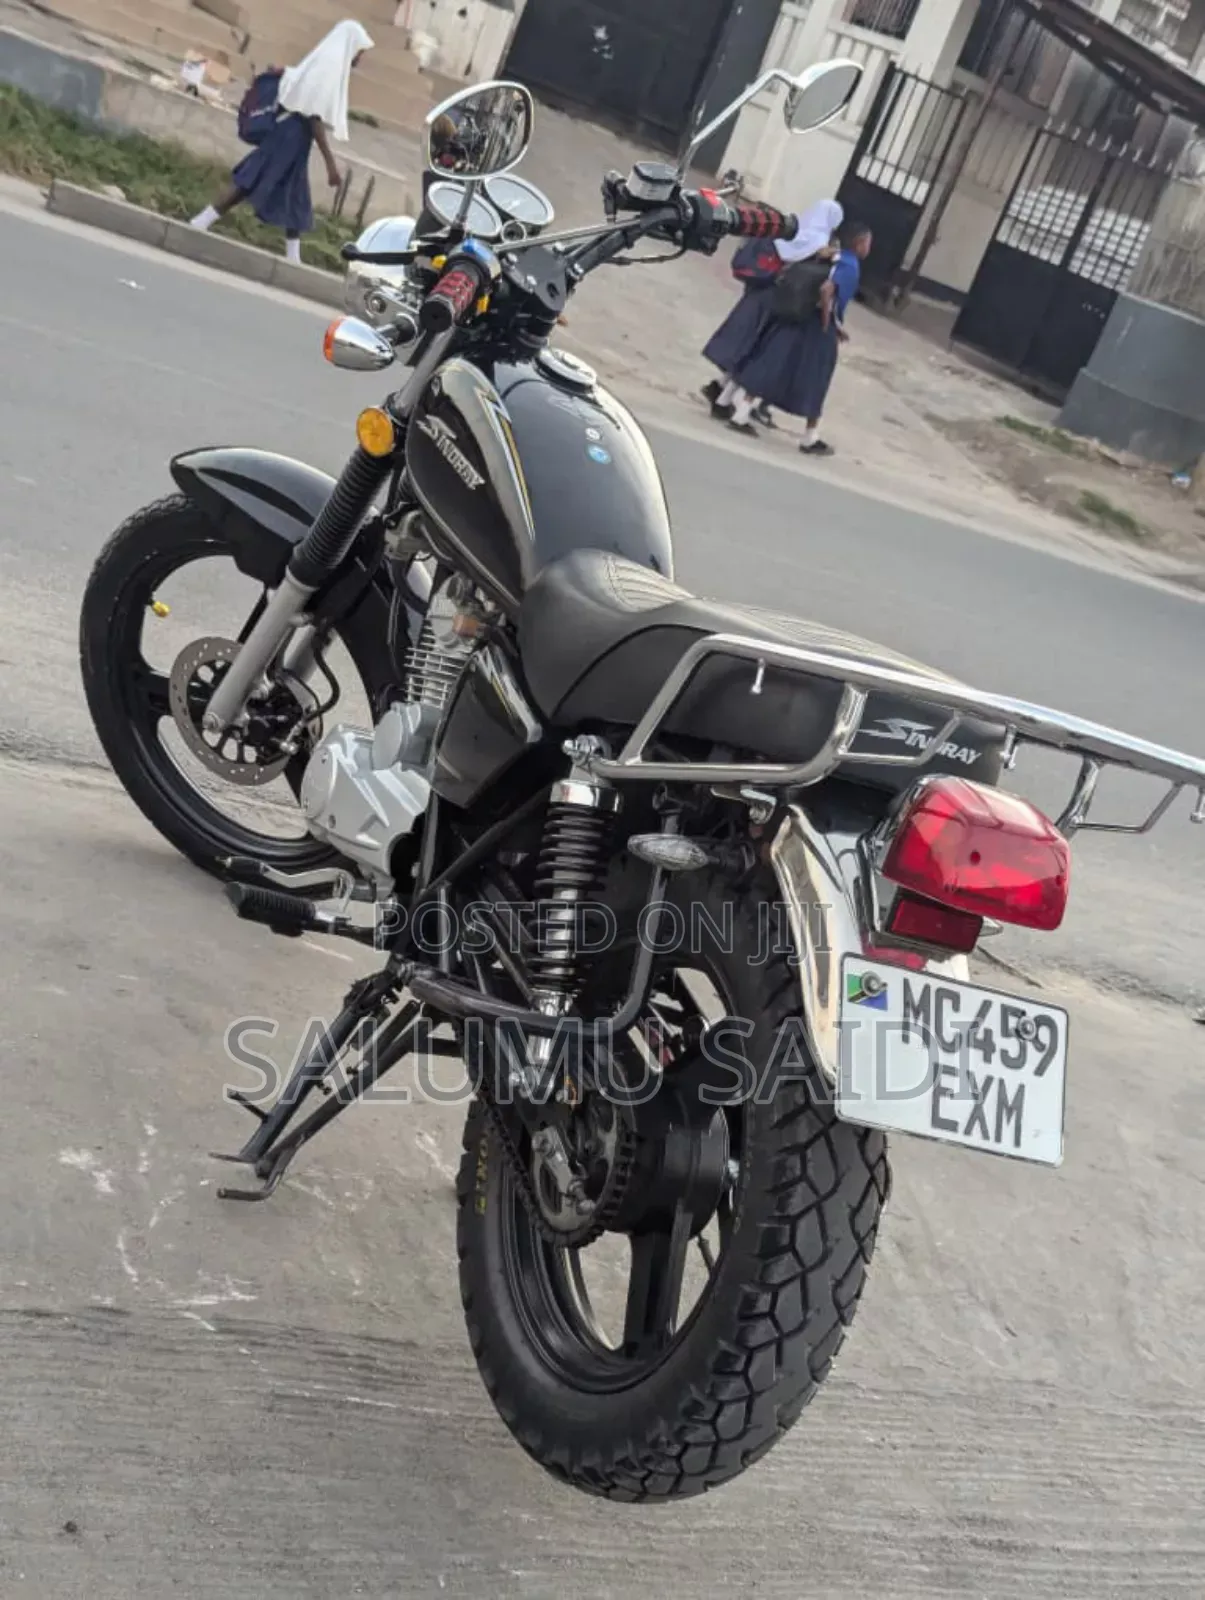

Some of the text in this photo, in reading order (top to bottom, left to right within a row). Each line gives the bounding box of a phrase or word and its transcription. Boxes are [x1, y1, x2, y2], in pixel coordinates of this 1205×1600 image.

[856, 717, 983, 765] SINRAY
[901, 976, 1059, 1077] MC459
[930, 1062, 1026, 1149] EXM
